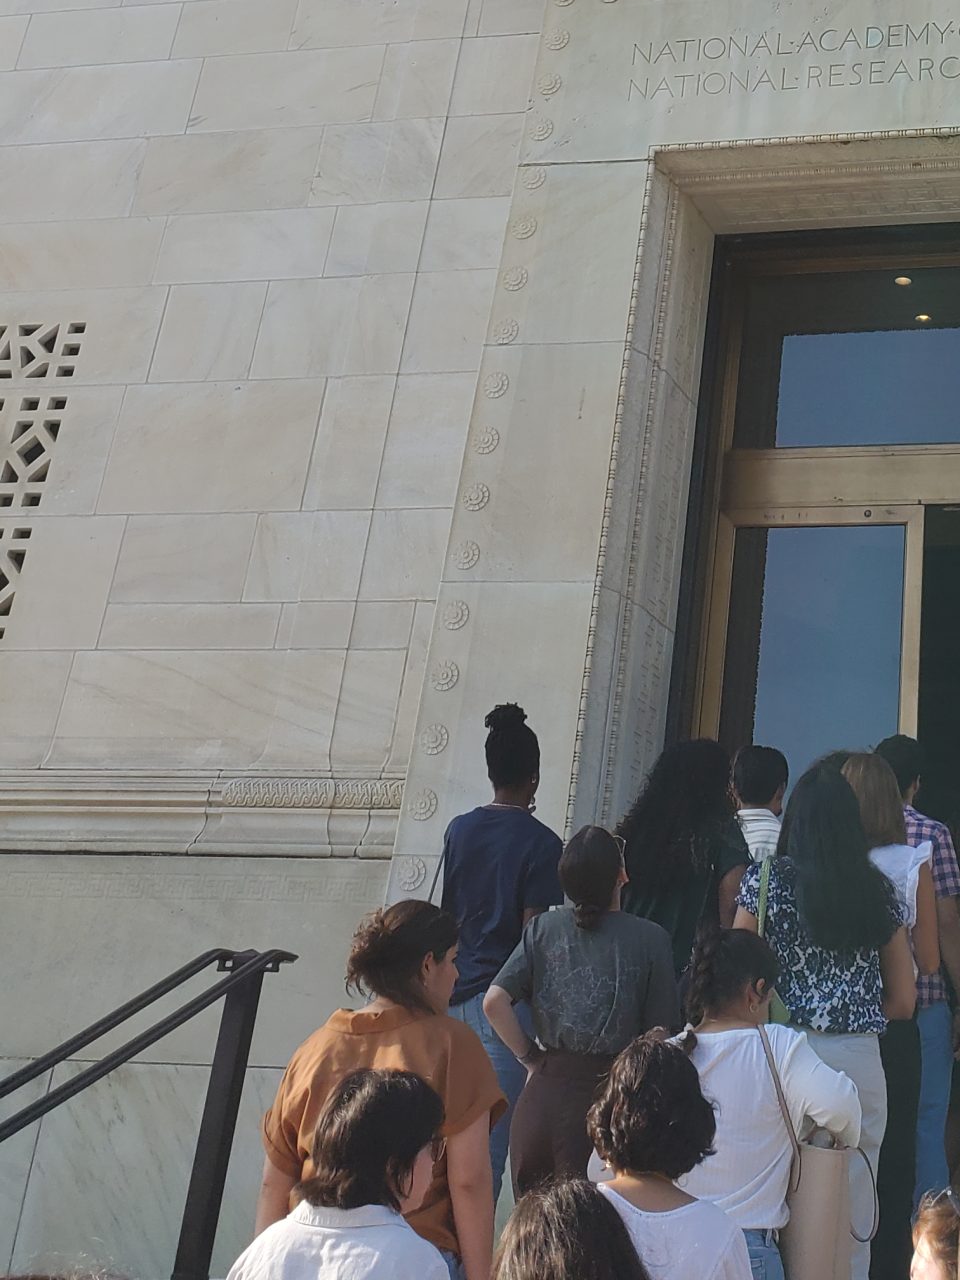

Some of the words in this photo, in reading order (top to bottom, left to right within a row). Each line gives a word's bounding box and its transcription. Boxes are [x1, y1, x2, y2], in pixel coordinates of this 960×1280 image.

[631, 33, 793, 65] NATIONAL
[797, 21, 954, 53] ACADEMY
[628, 67, 798, 102] NATIONAL
